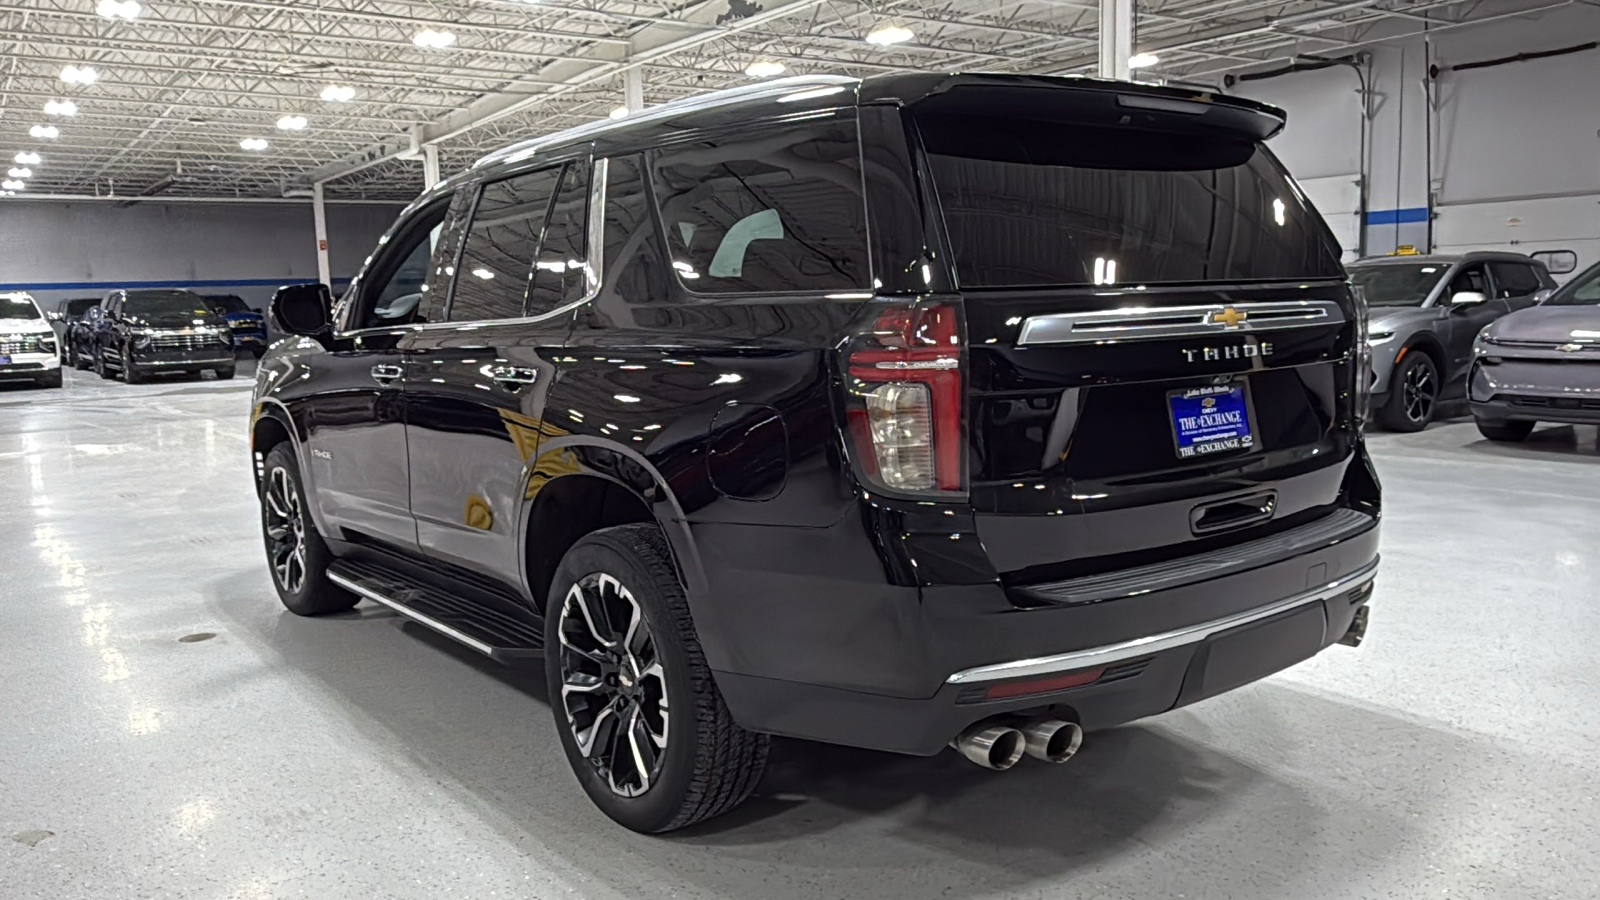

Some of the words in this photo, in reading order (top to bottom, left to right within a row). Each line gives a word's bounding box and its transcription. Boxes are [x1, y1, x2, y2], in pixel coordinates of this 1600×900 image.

[1182, 343, 1273, 362] TAHOE
[1179, 416, 1198, 431] THE
[1200, 410, 1243, 428] EXCHANGE
[1180, 446, 1196, 457] THE
[1200, 439, 1240, 454] EXCHANGE
